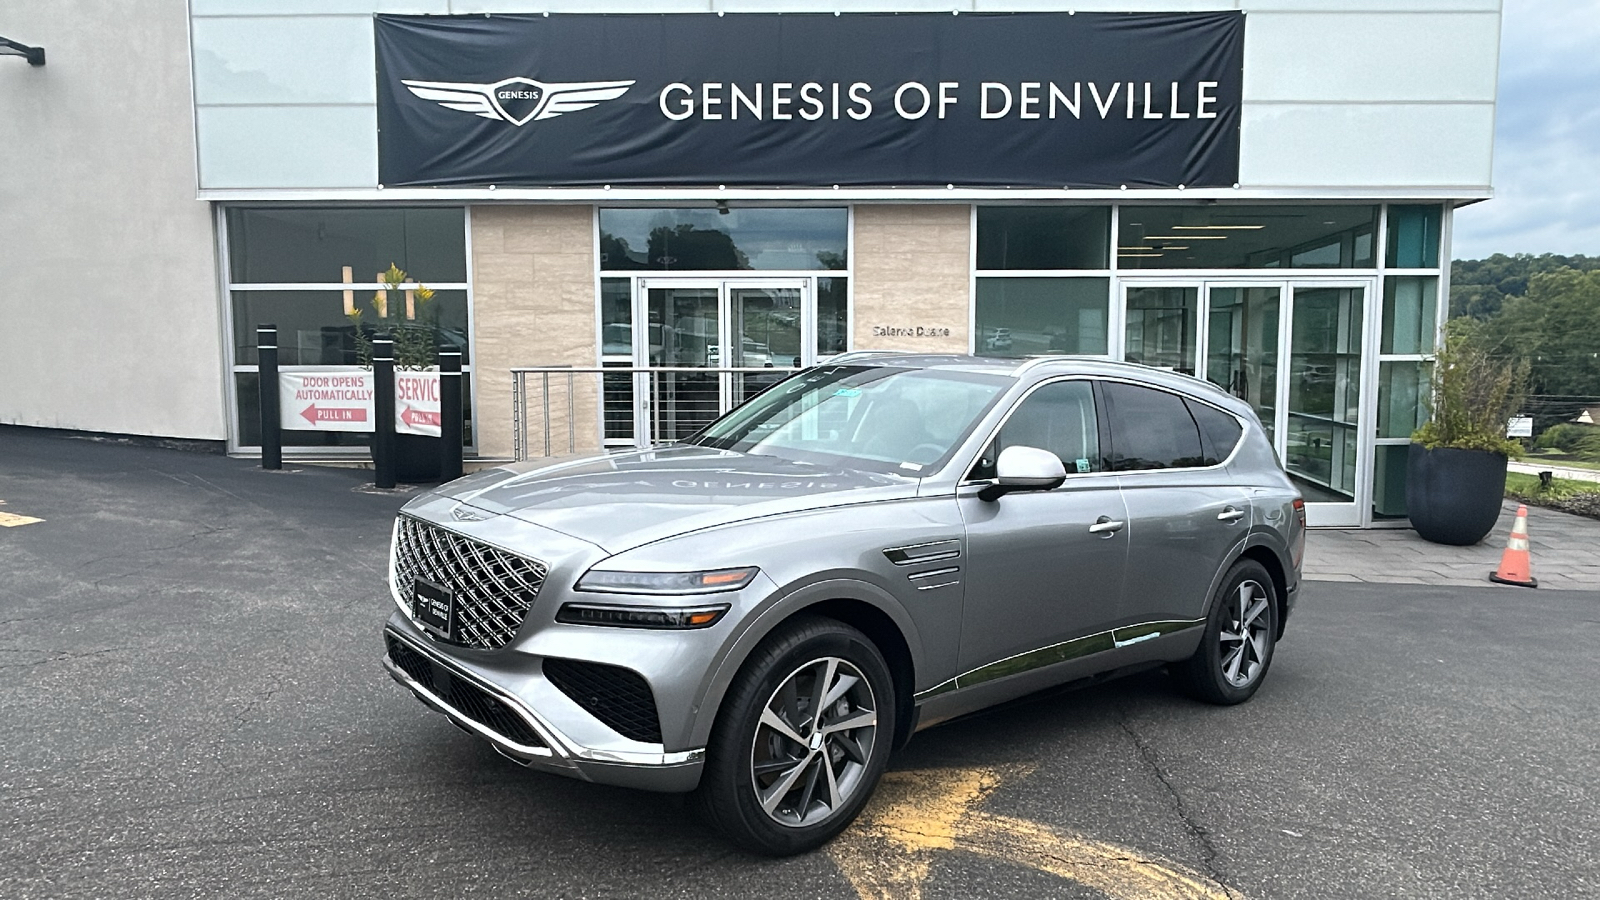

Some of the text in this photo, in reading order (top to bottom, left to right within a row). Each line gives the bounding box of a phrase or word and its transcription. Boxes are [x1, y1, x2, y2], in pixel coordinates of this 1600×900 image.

[498, 90, 539, 100] GENESIS
[659, 81, 1219, 121] GENESIS OF DENVILLE
[302, 376, 364, 388] DOOR OPENS
[295, 389, 373, 401] AUTOMATICALLY
[398, 378, 440, 402] SERVIC
[317, 409, 352, 420] PULL IN
